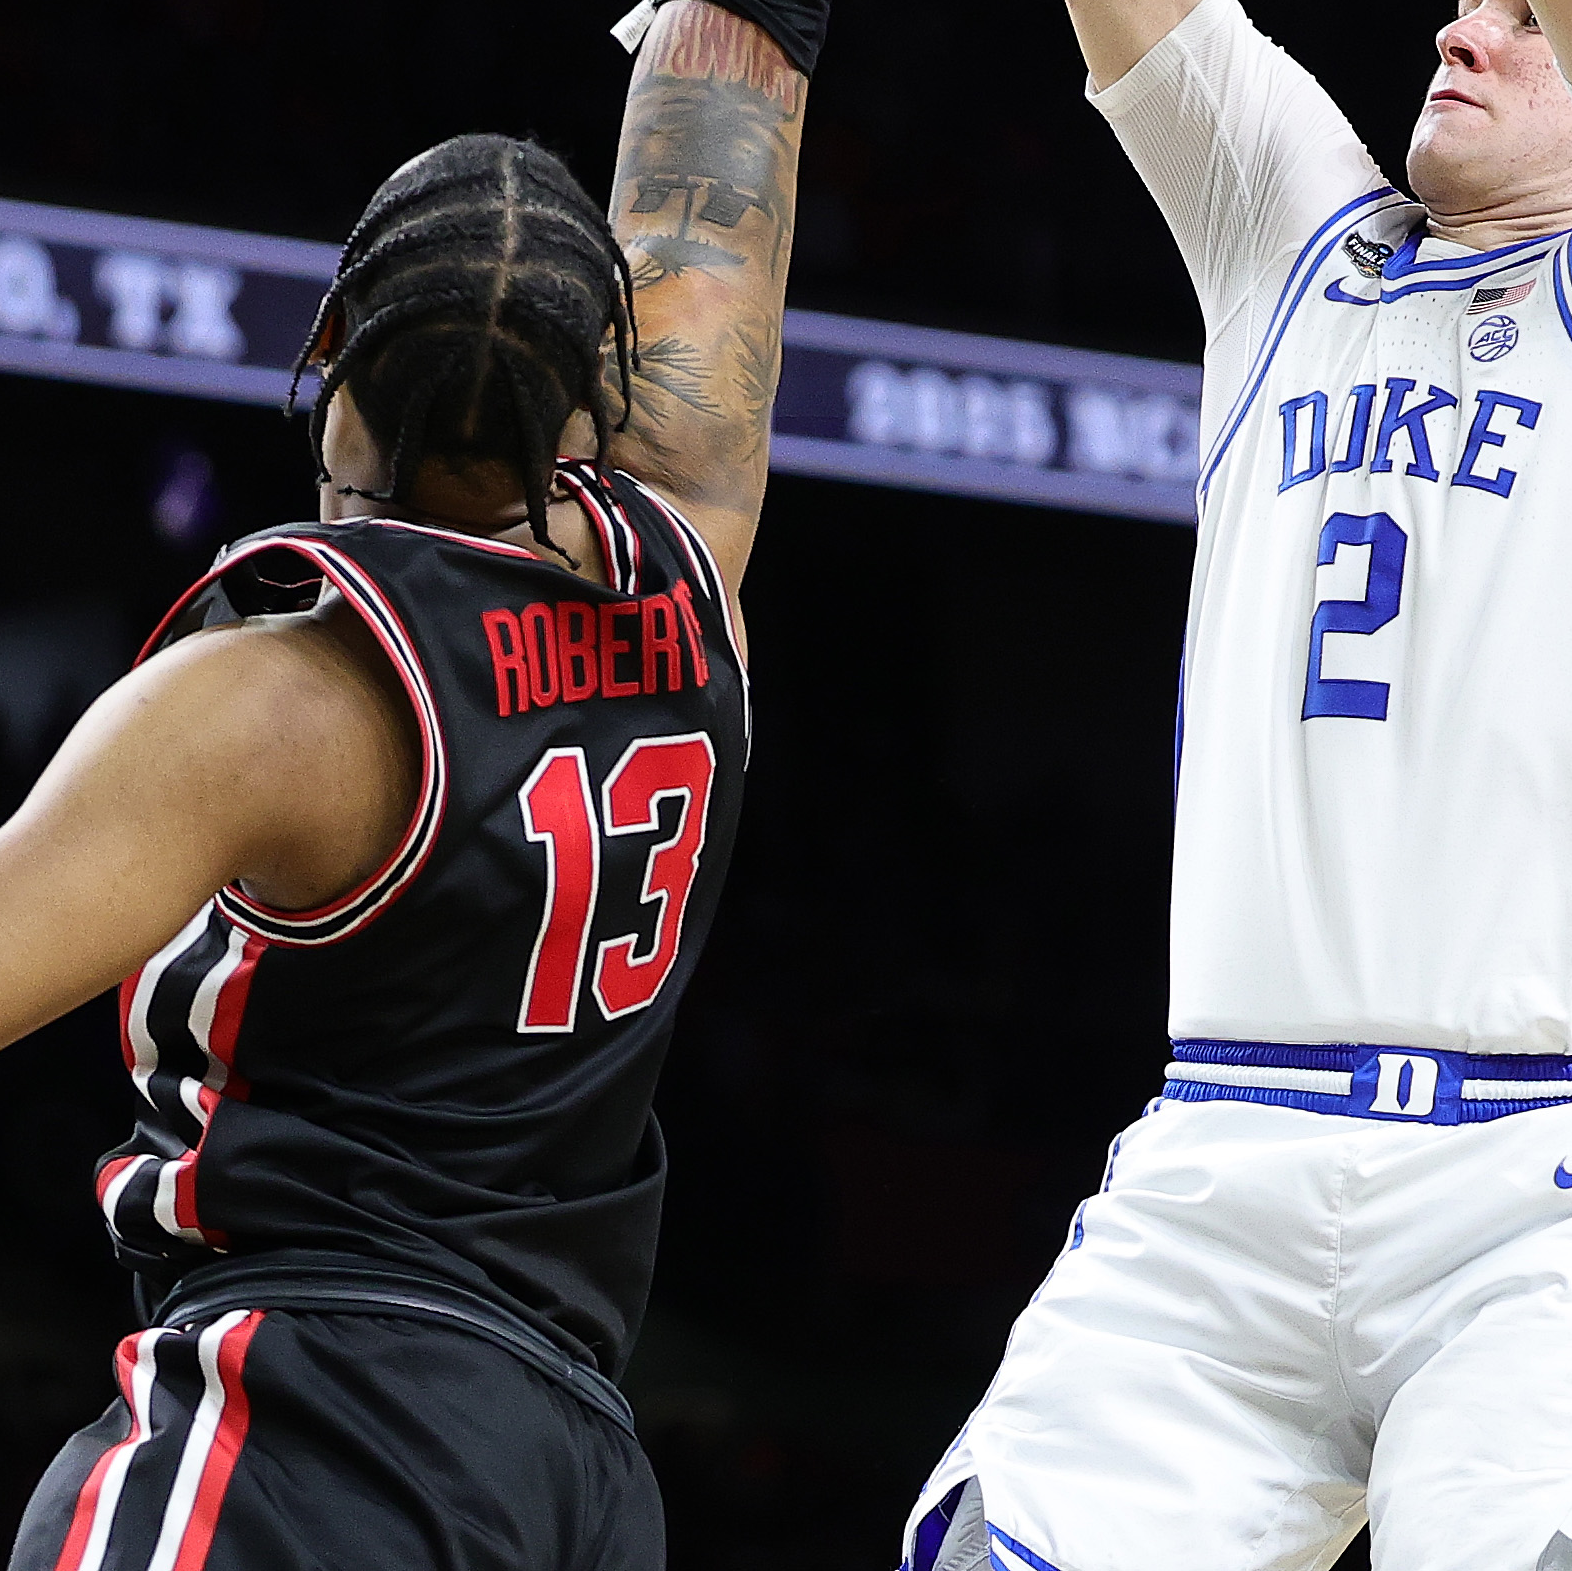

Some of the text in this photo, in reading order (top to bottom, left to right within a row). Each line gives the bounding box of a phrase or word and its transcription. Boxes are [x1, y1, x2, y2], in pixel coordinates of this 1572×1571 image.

[95, 247, 246, 360] TX
[1474, 328, 1515, 346] ACC
[1278, 377, 1542, 499] DUKE
[481, 577, 710, 718] ROBERT
[1301, 512, 1408, 722] 2
[516, 730, 716, 1034] 13
